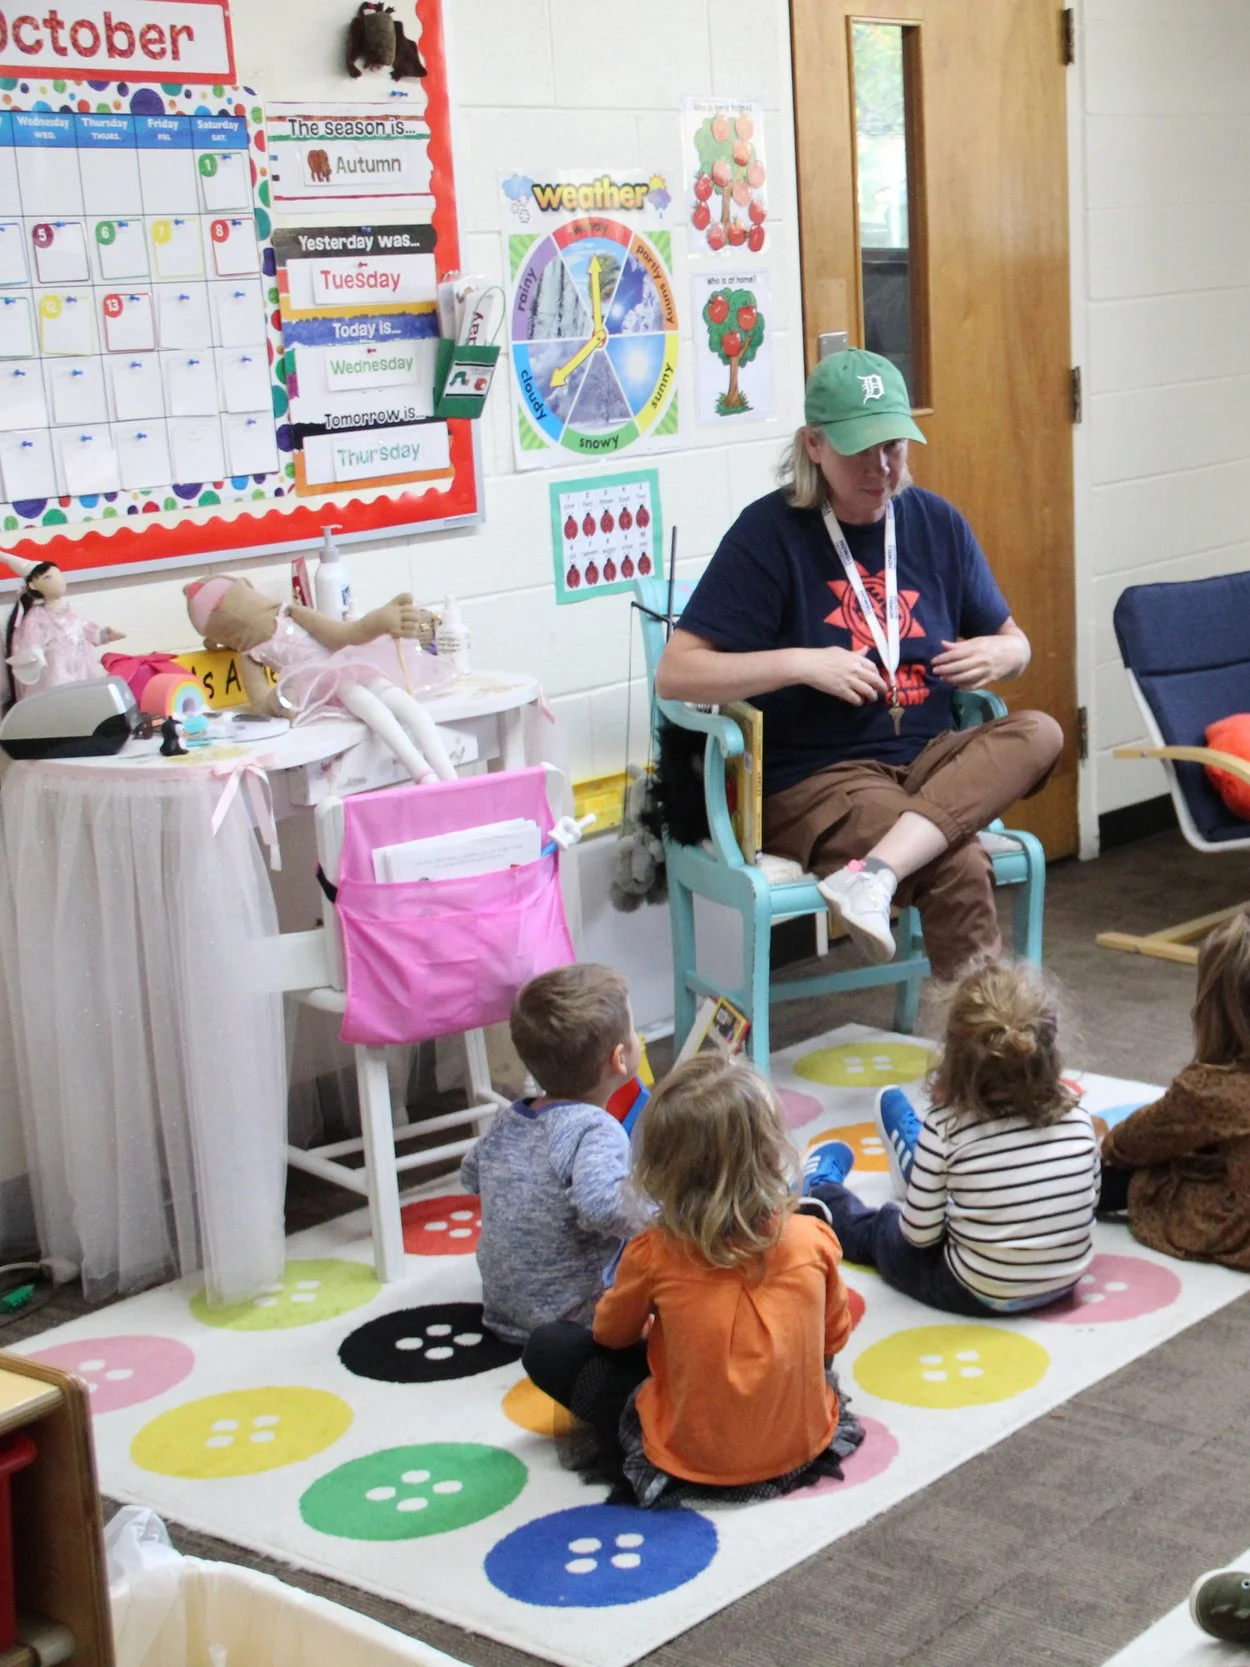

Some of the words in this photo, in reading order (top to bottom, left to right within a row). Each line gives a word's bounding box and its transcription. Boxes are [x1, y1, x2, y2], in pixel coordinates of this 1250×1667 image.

[17, 117, 70, 129] Wednesday
[81, 118, 128, 129] Thursday
[148, 119, 178, 130] Friday
[196, 120, 239, 131] Saturday
[288, 119, 319, 135] The
[325, 121, 386, 135] season
[391, 120, 416, 135] is...
[205, 159, 212, 171] 1
[336, 156, 402, 173] Autumn
[532, 174, 649, 212] weather
[39, 229, 47, 241] 5
[102, 226, 110, 239] 6
[158, 225, 165, 237] 7
[215, 224, 224, 237] 8
[298, 235, 374, 252] Yesterday
[378, 234, 421, 248] was...
[320, 270, 401, 292] Tuesday
[636, 245, 662, 280] partly
[660, 283, 674, 324] sunny
[707, 276, 720, 285] Who
[518, 267, 538, 312] rainy
[46, 301, 57, 313] 12
[107, 300, 118, 312] 13
[332, 322, 376, 339] Today
[379, 320, 401, 335] is...
[330, 357, 413, 376] Wednesday
[650, 363, 674, 409] sunny
[856, 373, 886, 405] D
[521, 369, 547, 421] cloudy
[325, 408, 401, 429] Tomorrow
[404, 406, 426, 421] is...
[579, 435, 619, 449] snowy
[336, 442, 421, 467] Thursday
